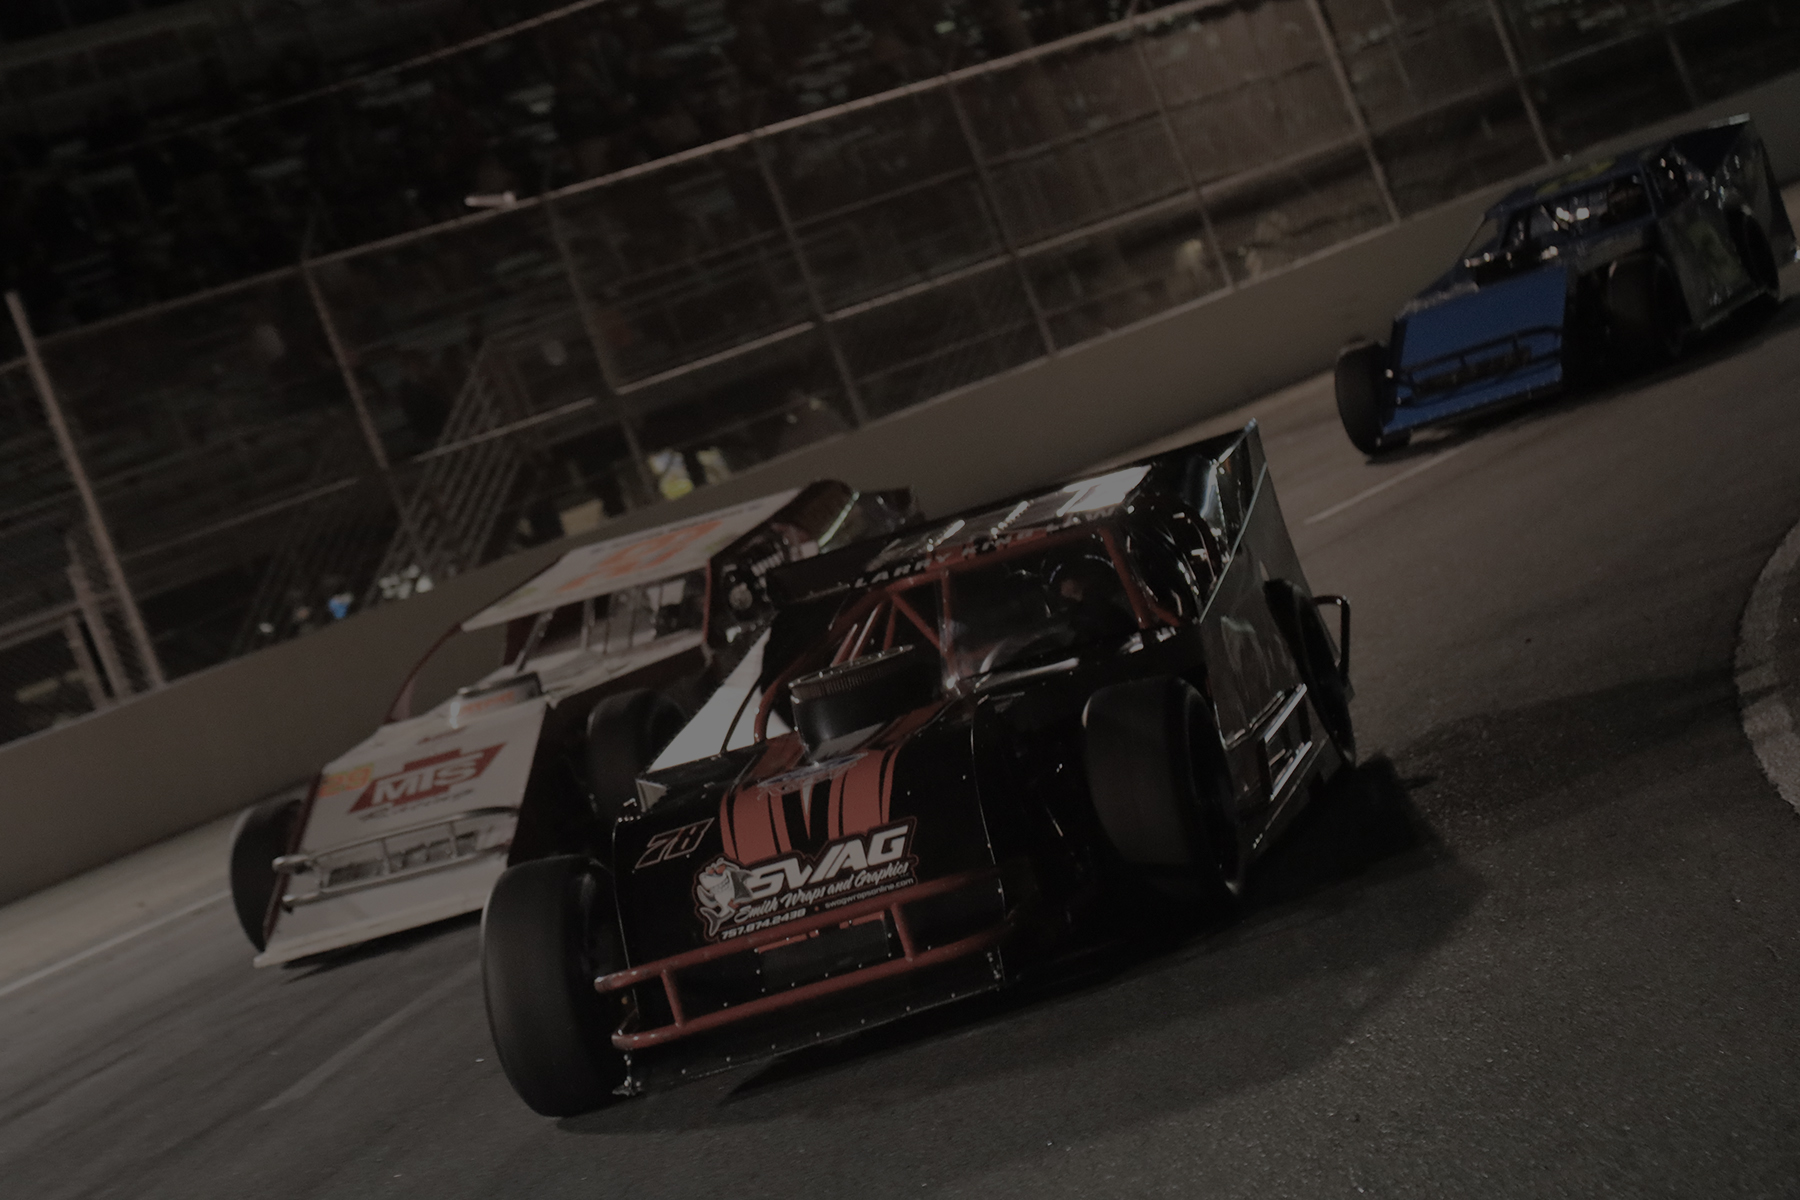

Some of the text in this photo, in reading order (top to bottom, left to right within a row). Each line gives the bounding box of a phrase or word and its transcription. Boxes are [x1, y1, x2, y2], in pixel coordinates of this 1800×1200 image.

[734, 900, 779, 923] Smith
[780, 886, 826, 908] Wraps
[827, 874, 851, 895] and
[854, 861, 910, 887] Graphics
[750, 825, 909, 900] SWAG
